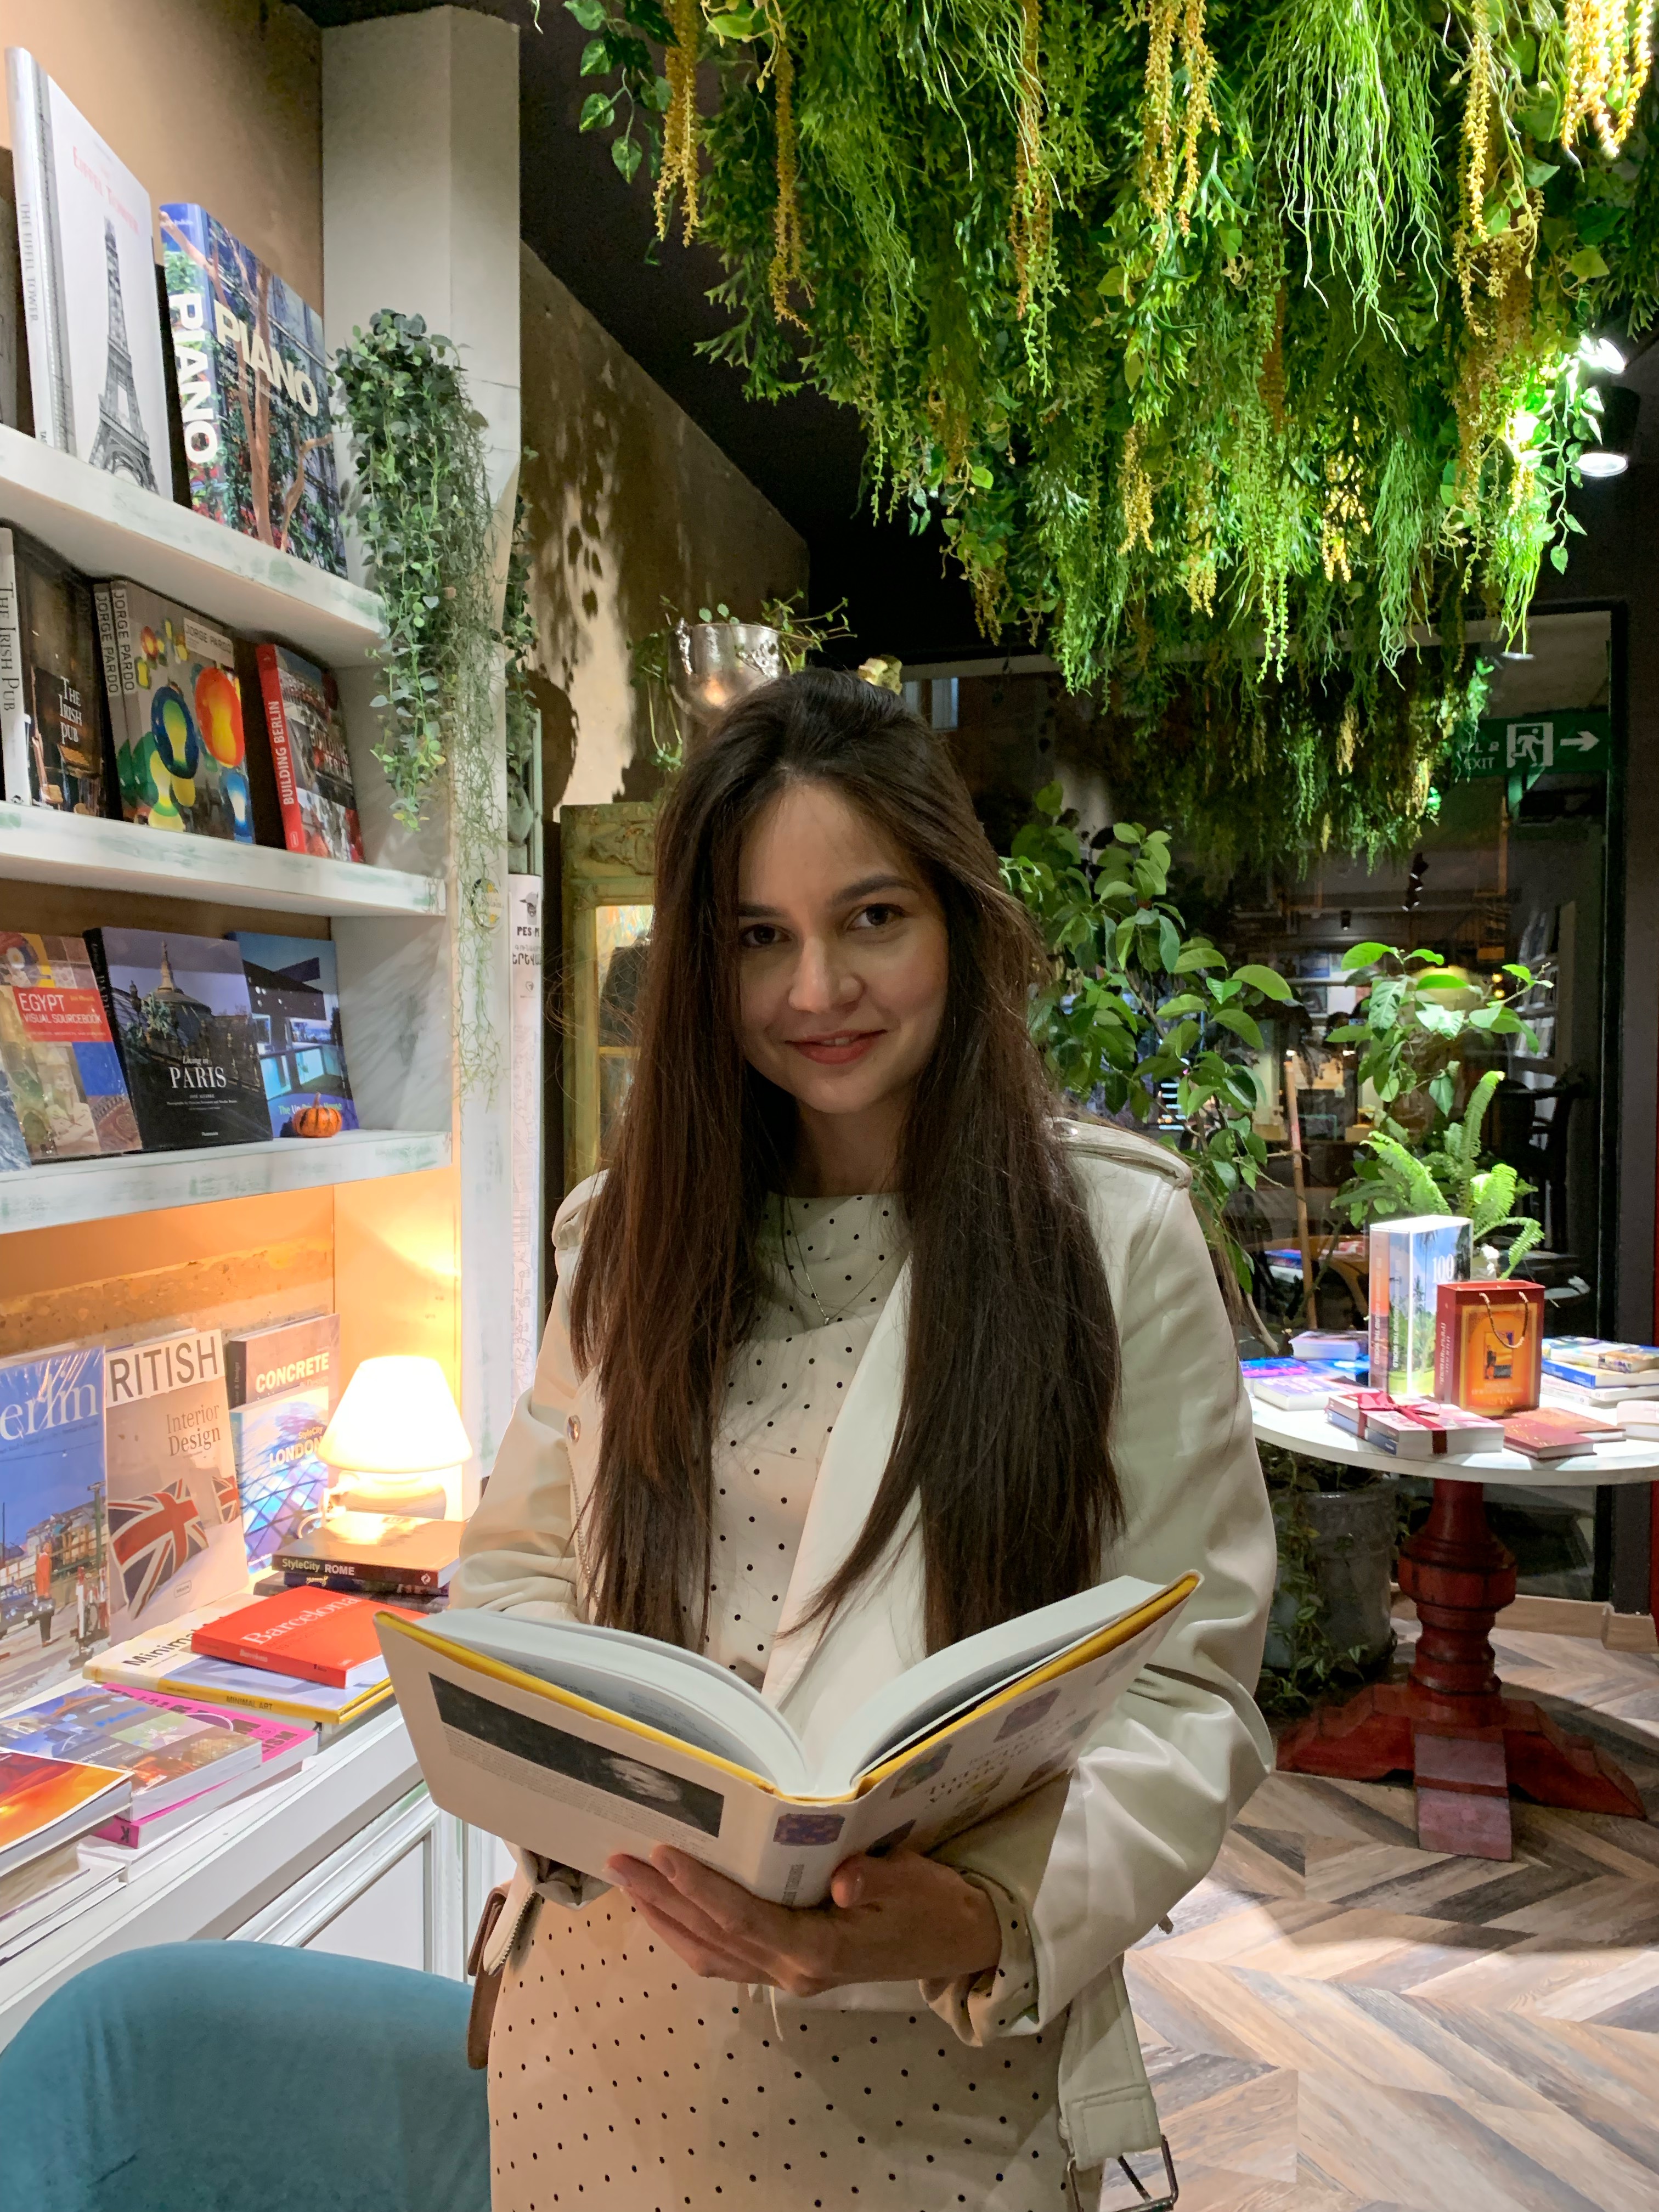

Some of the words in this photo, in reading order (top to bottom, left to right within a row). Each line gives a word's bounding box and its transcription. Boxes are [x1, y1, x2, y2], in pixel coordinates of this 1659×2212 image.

[26, 278, 38, 322] TOWER
[213, 298, 319, 417] PIANO
[168, 292, 218, 464] PIANO
[0, 583, 14, 619] THE
[0, 627, 16, 670] IRISH
[96, 595, 112, 642] JORGE
[104, 646, 119, 693] PARDO
[113, 591, 129, 639] JORGE
[121, 644, 135, 691] PARDO
[2, 677, 20, 712] PUB
[60, 675, 82, 707] THE
[58, 694, 82, 726] IRISH
[268, 701, 285, 744] BERLIN
[275, 746, 295, 805] BUILDING
[1464, 757, 1495, 769] EXIT
[516, 926, 532, 936] PES
[18, 992, 65, 1012] EGYPT
[23, 1013, 52, 1024] VISUAL
[52, 1013, 103, 1024] SOURCEBOOK
[168, 1066, 227, 1088] PARIS
[278, 1105, 291, 1115] The
[1431, 1253, 1454, 1284] 100
[109, 1335, 219, 1403] RITISH
[255, 1351, 330, 1393] CONCRETE
[0, 1373, 99, 1441] erlin
[166, 1404, 219, 1434] Interior
[167, 1427, 221, 1457] Design
[281, 1558, 320, 1573] StyleCity
[324, 1564, 356, 1576] ROME
[240, 1596, 364, 1645] Barcelona
[225, 1695, 256, 1709] MINIMAL
[258, 1702, 273, 1711] ART
